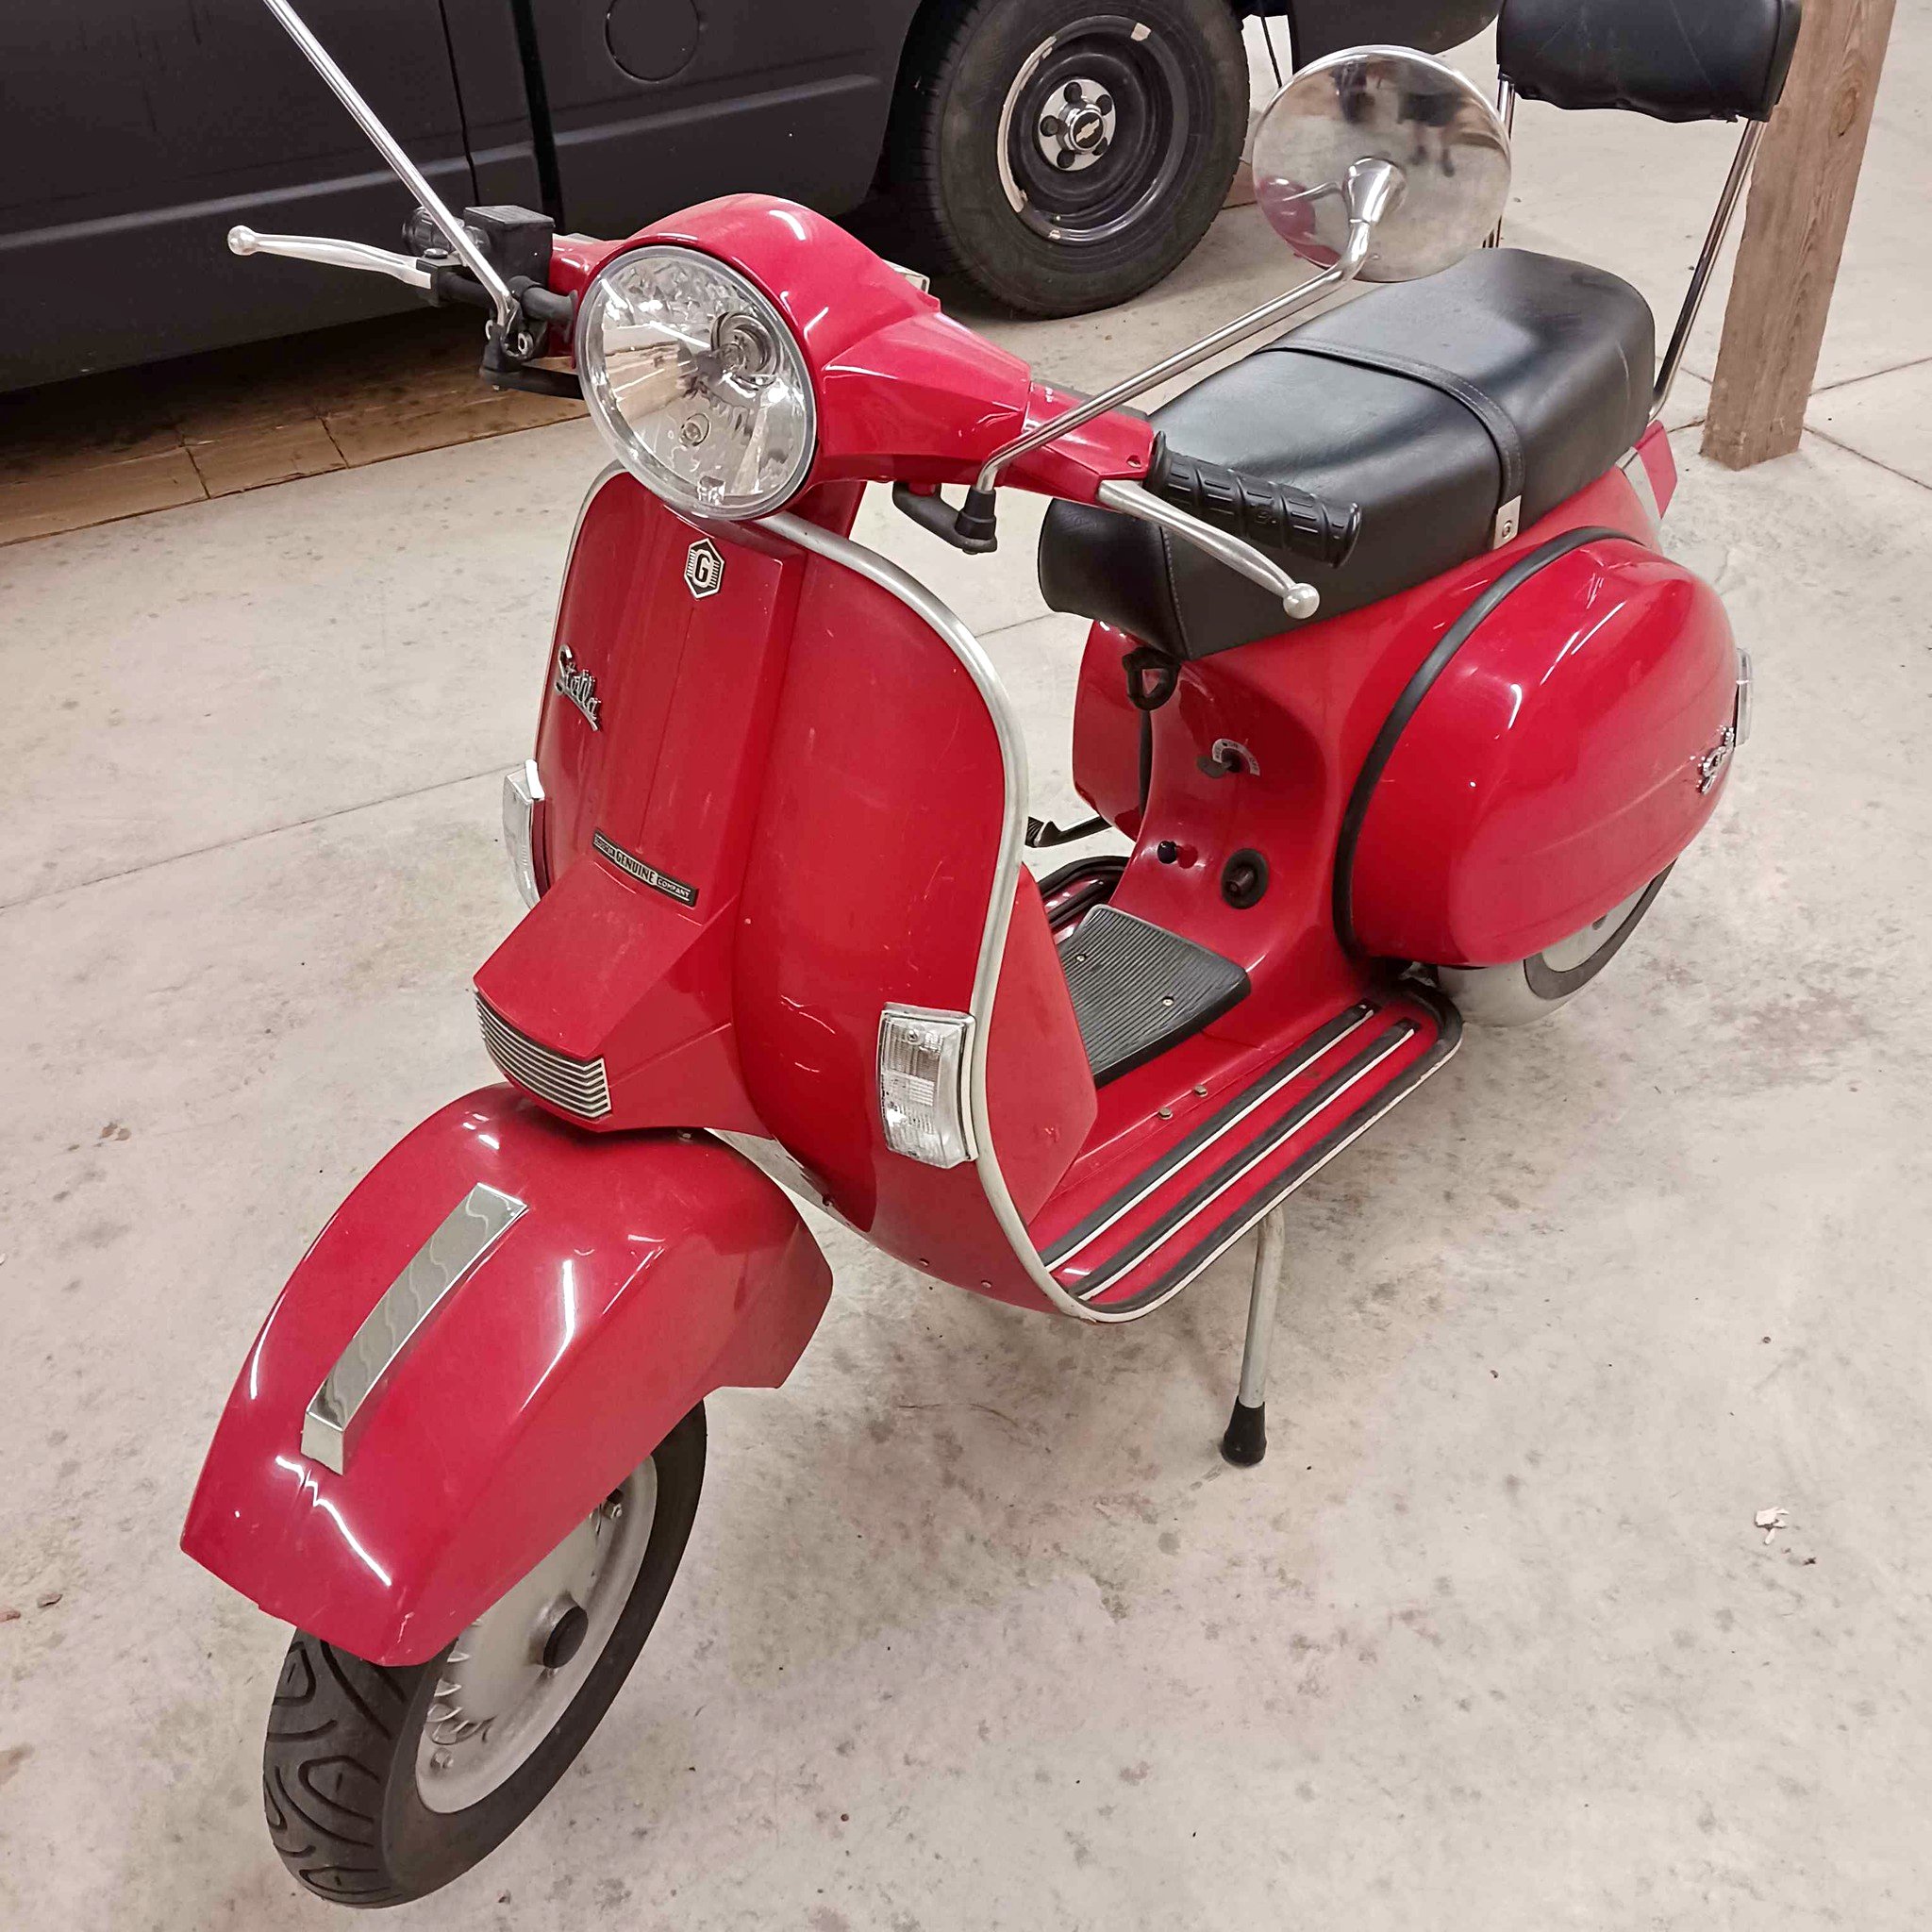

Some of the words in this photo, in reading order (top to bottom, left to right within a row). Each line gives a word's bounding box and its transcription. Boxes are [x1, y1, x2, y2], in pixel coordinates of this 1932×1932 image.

[694, 553, 710, 583] G
[616, 850, 656, 883] GENUINE
[658, 877, 691, 898] COMPANY
